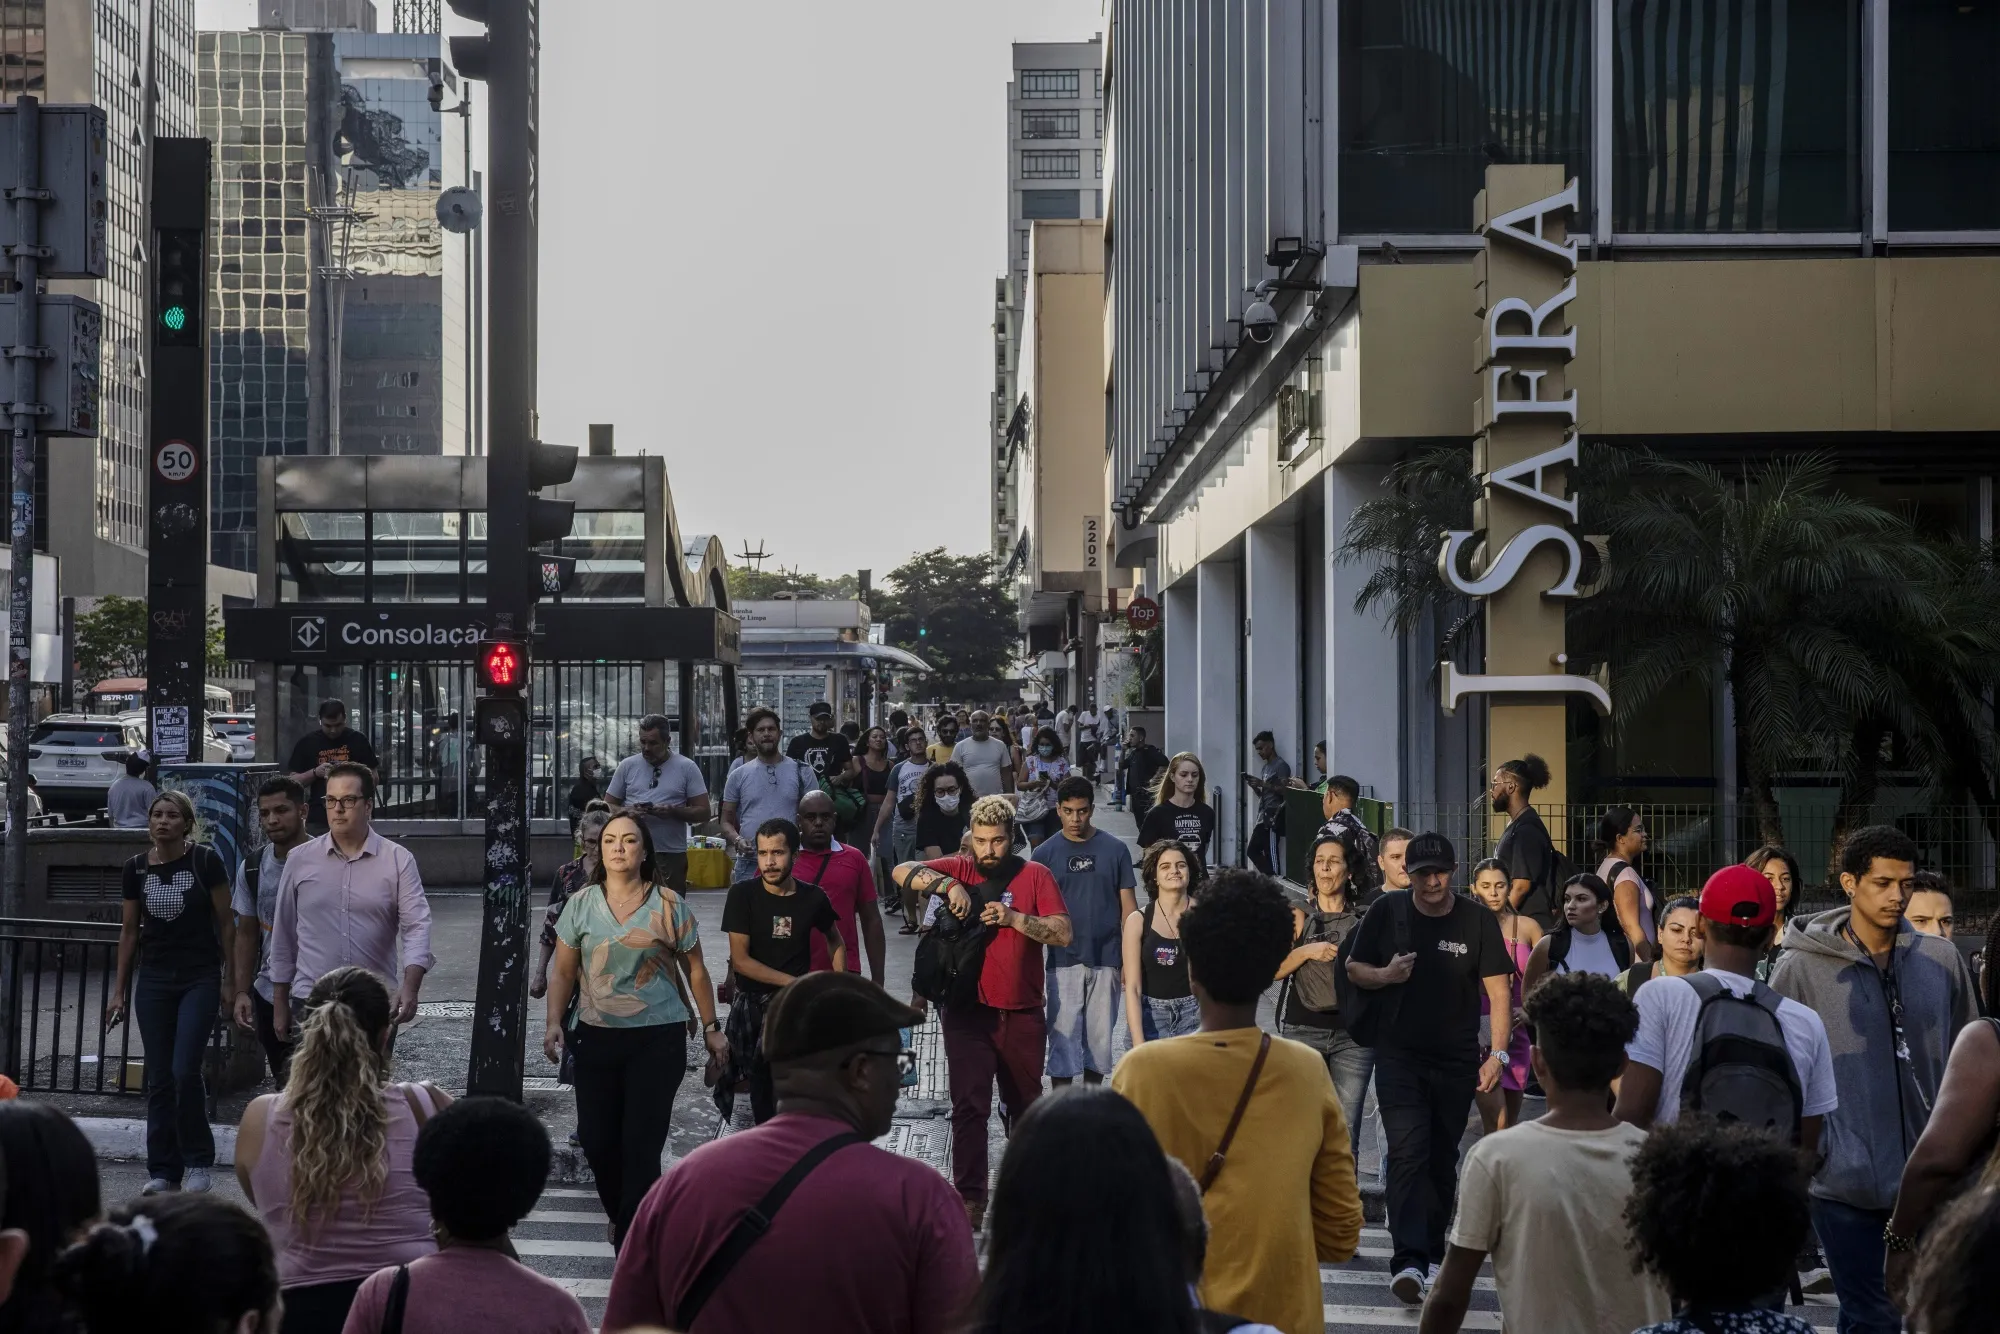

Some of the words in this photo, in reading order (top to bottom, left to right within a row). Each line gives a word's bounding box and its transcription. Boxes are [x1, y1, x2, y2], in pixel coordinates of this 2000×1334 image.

[1440, 175, 1581, 598] SAFRA
[162, 451, 192, 470] 50
[1087, 520, 1097, 567] 2202
[747, 614, 767, 622] Limpa
[1131, 605, 1155, 621] Top
[1441, 652, 1612, 716] J.
[156, 707, 178, 715] AULAS
